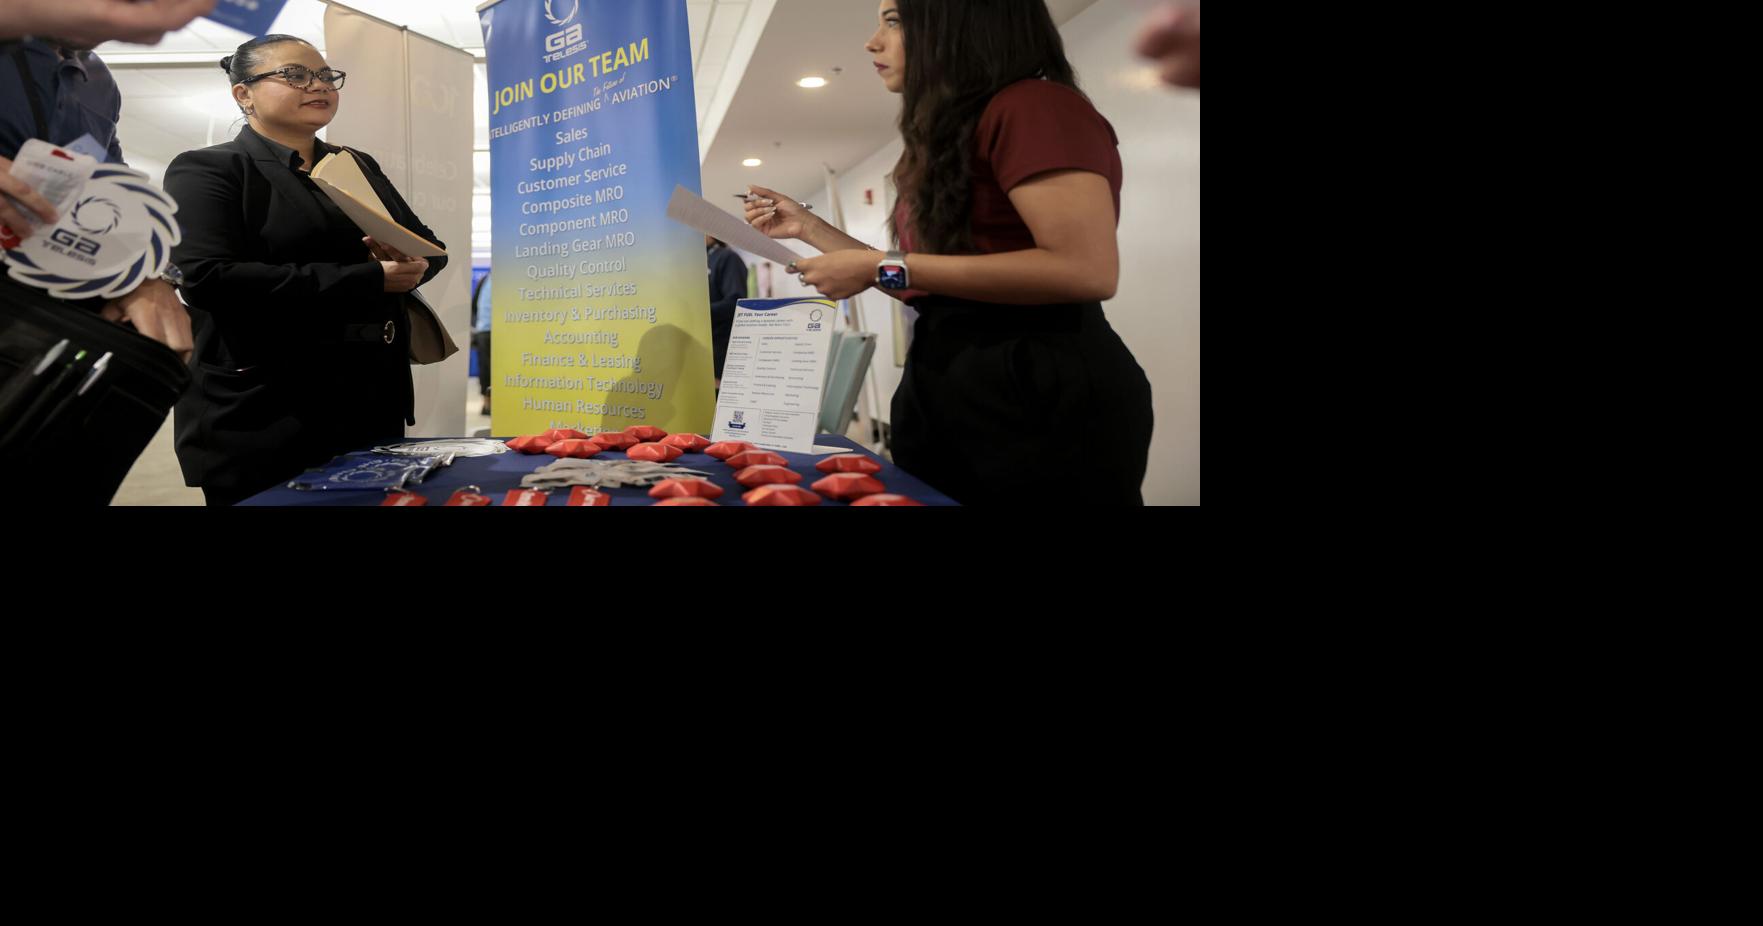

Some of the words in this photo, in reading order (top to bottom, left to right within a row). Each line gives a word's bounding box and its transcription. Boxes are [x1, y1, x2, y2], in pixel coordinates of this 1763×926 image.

[493, 78, 534, 115] JOIN
[540, 63, 585, 94] OUR
[588, 38, 649, 79] TEAM
[553, 97, 601, 123] DEFINING
[556, 128, 588, 145] Sales
[530, 151, 576, 172] Supply
[578, 142, 611, 162] Chain
[518, 171, 581, 195] Customer
[584, 163, 627, 183] Service
[522, 192, 592, 215] Composite
[595, 185, 624, 204] MRO
[520, 215, 596, 238] Component
[600, 208, 628, 225] MRO
[515, 241, 568, 259] Landing
[572, 238, 603, 253] Gear
[605, 231, 635, 249] MRO
[527, 261, 577, 280] Quality
[579, 257, 627, 275] Control
[518, 284, 582, 301] Technical
[586, 281, 637, 297] Services
[504, 308, 568, 325] Inventory
[571, 307, 580, 321] &
[583, 305, 657, 323] Purchasing
[544, 329, 619, 348] Accounting
[521, 352, 574, 367] Finance
[578, 352, 587, 367] &
[591, 354, 642, 372] Leasing
[504, 374, 584, 391] Information
[587, 376, 664, 400] Technology
[523, 397, 573, 413] Human
[575, 399, 645, 419] Resources
